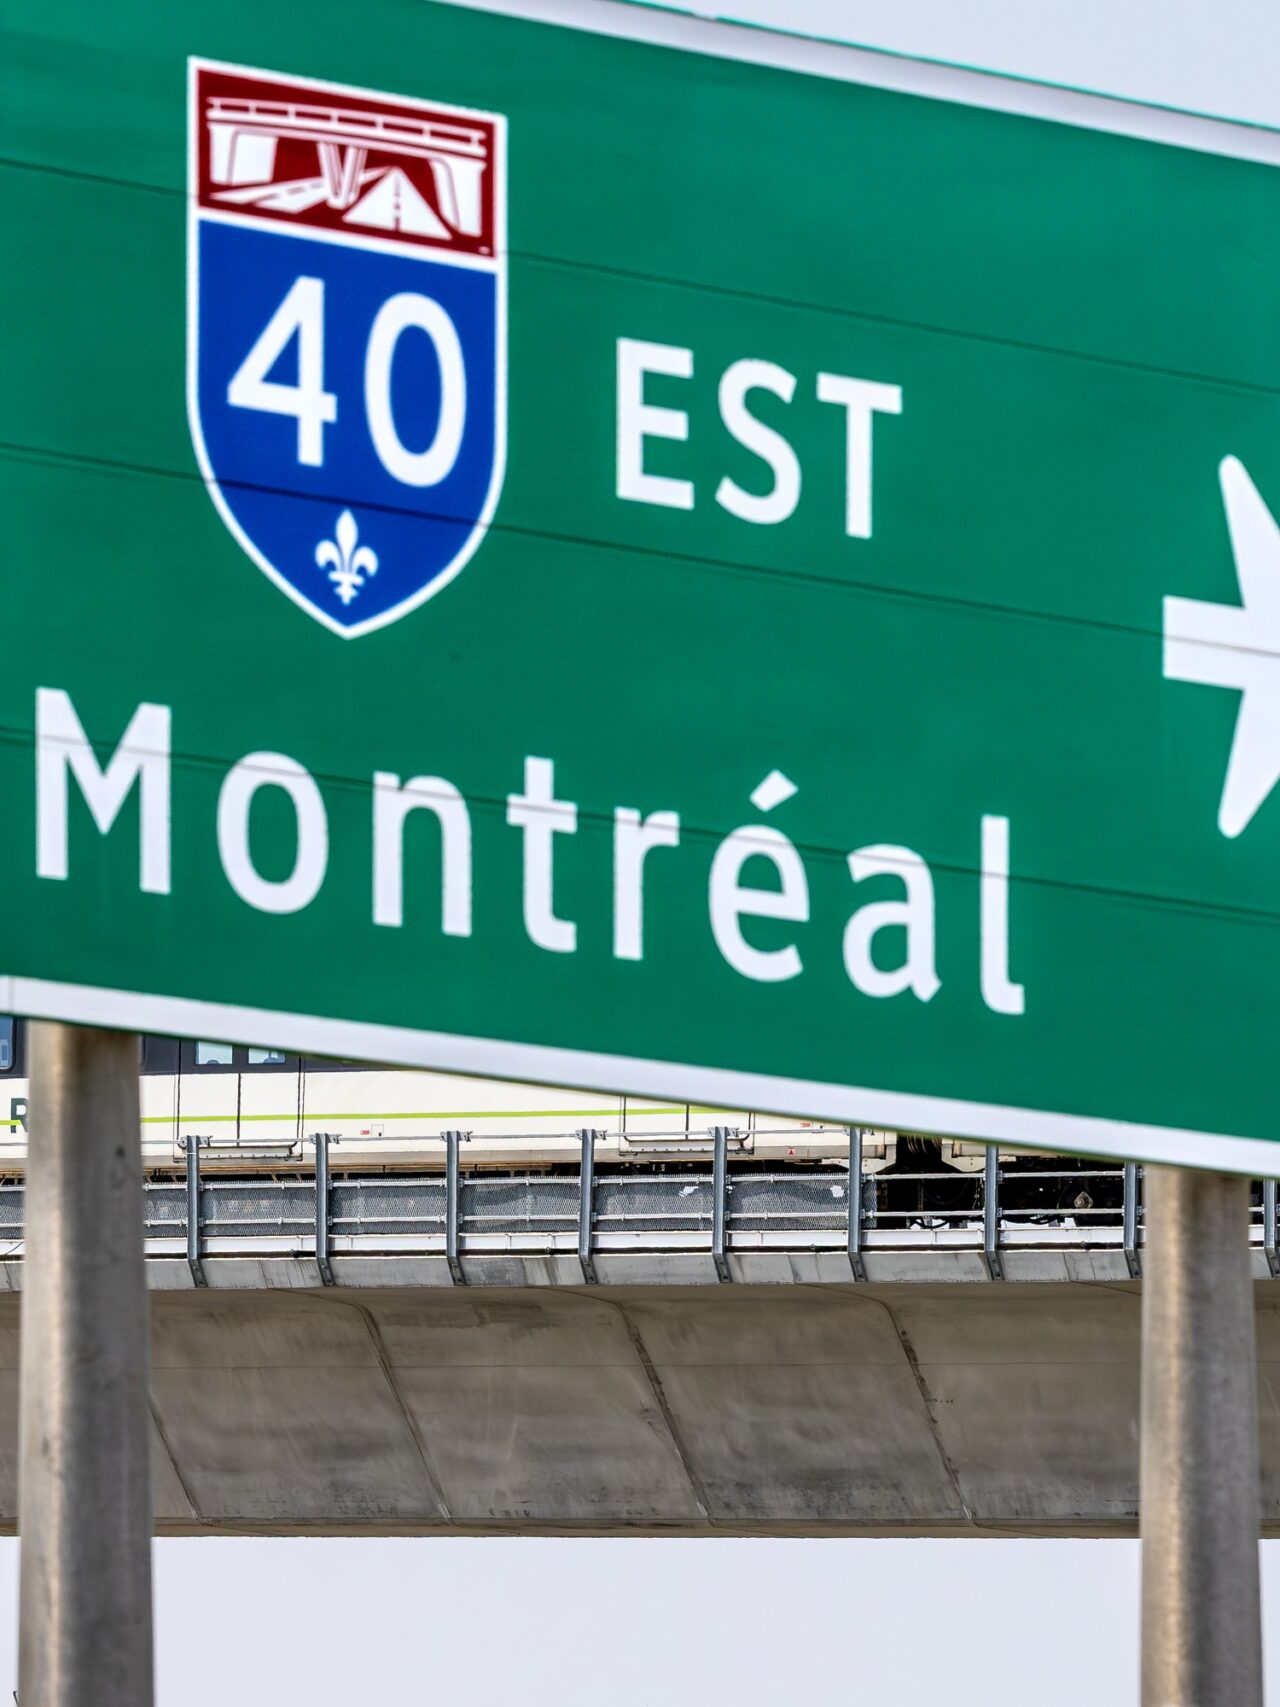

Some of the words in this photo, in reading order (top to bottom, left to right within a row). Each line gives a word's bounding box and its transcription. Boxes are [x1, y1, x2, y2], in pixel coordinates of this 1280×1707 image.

[227, 275, 467, 487] 40
[615, 337, 903, 539] EST
[35, 686, 1025, 1015] Montréal
[11, 1098, 30, 1133] R
